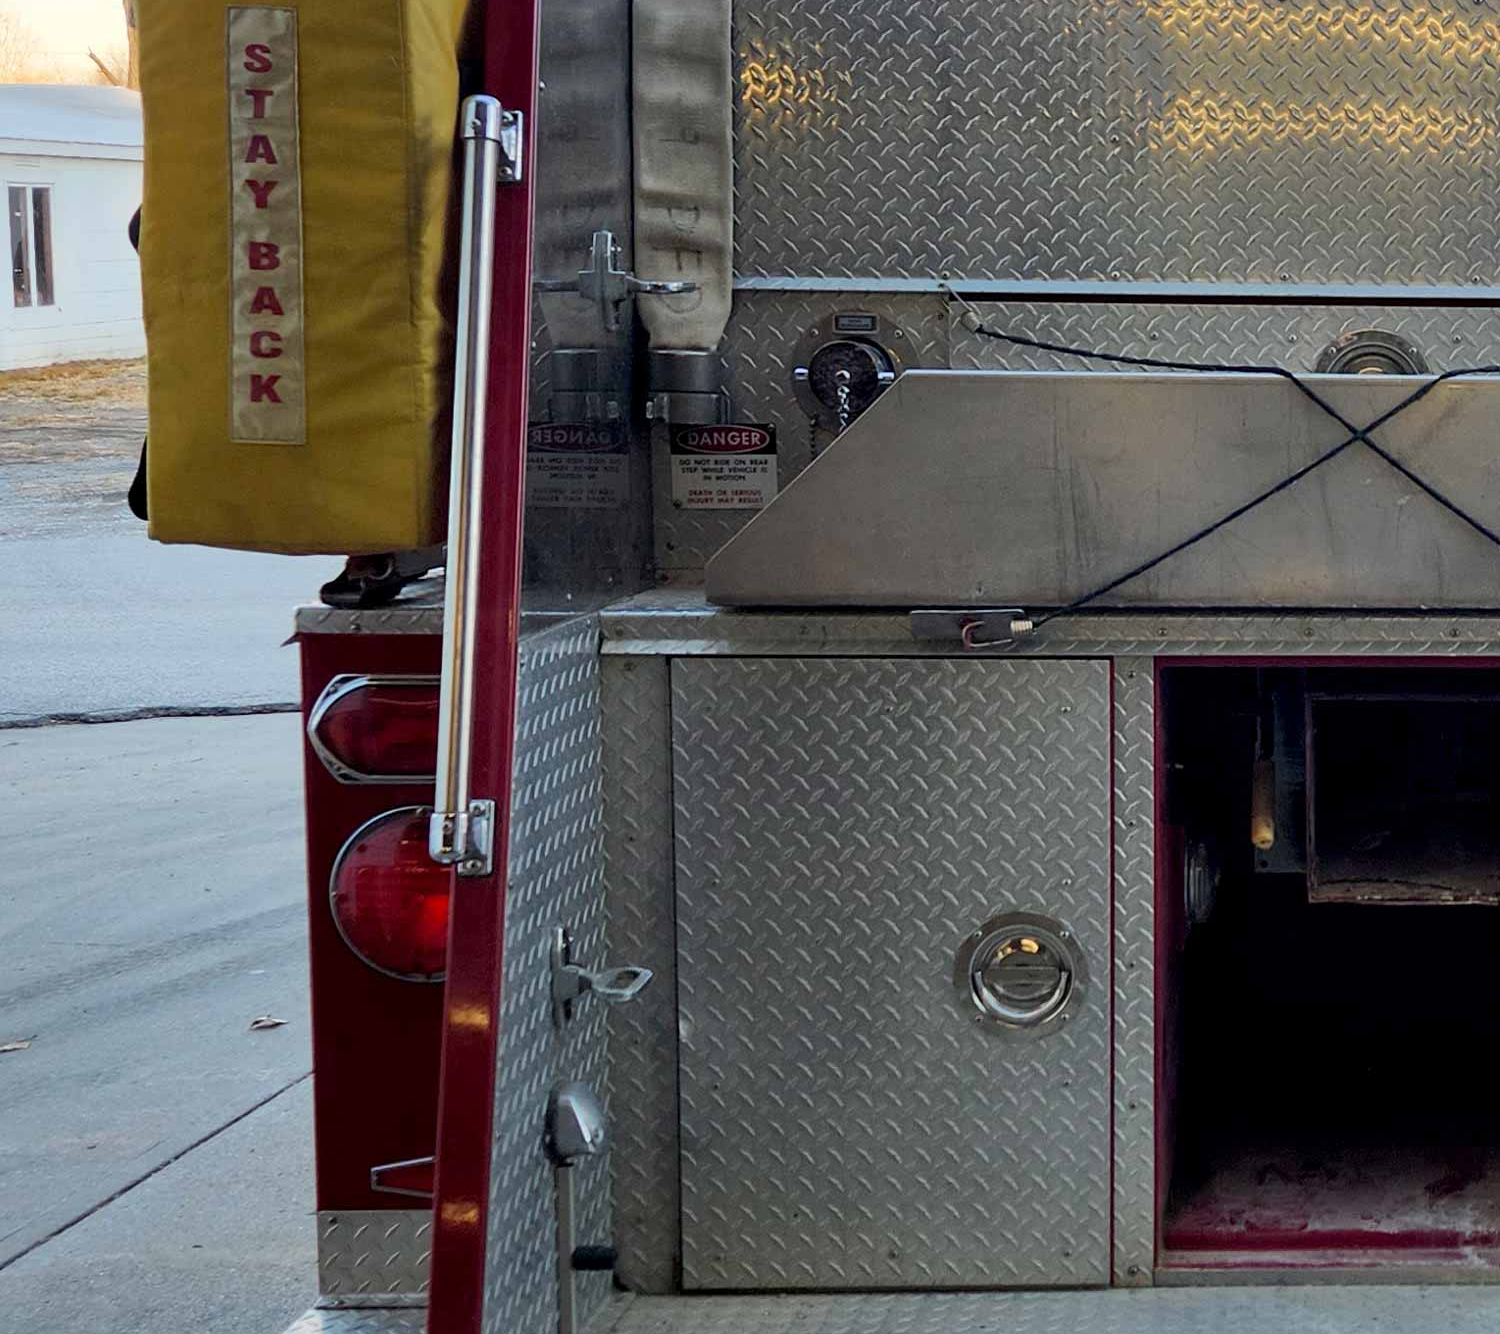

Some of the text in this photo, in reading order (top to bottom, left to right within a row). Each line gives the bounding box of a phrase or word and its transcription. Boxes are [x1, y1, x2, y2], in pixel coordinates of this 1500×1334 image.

[243, 43, 283, 405] STAY BACK
[688, 431, 761, 446] DANGER
[680, 458, 768, 466] DO NOT RIDE ON REAR
[681, 466, 697, 474] STEP
[701, 466, 723, 474] WHILE
[728, 466, 757, 474] VEHICLE
[715, 474, 746, 482] MOTION
